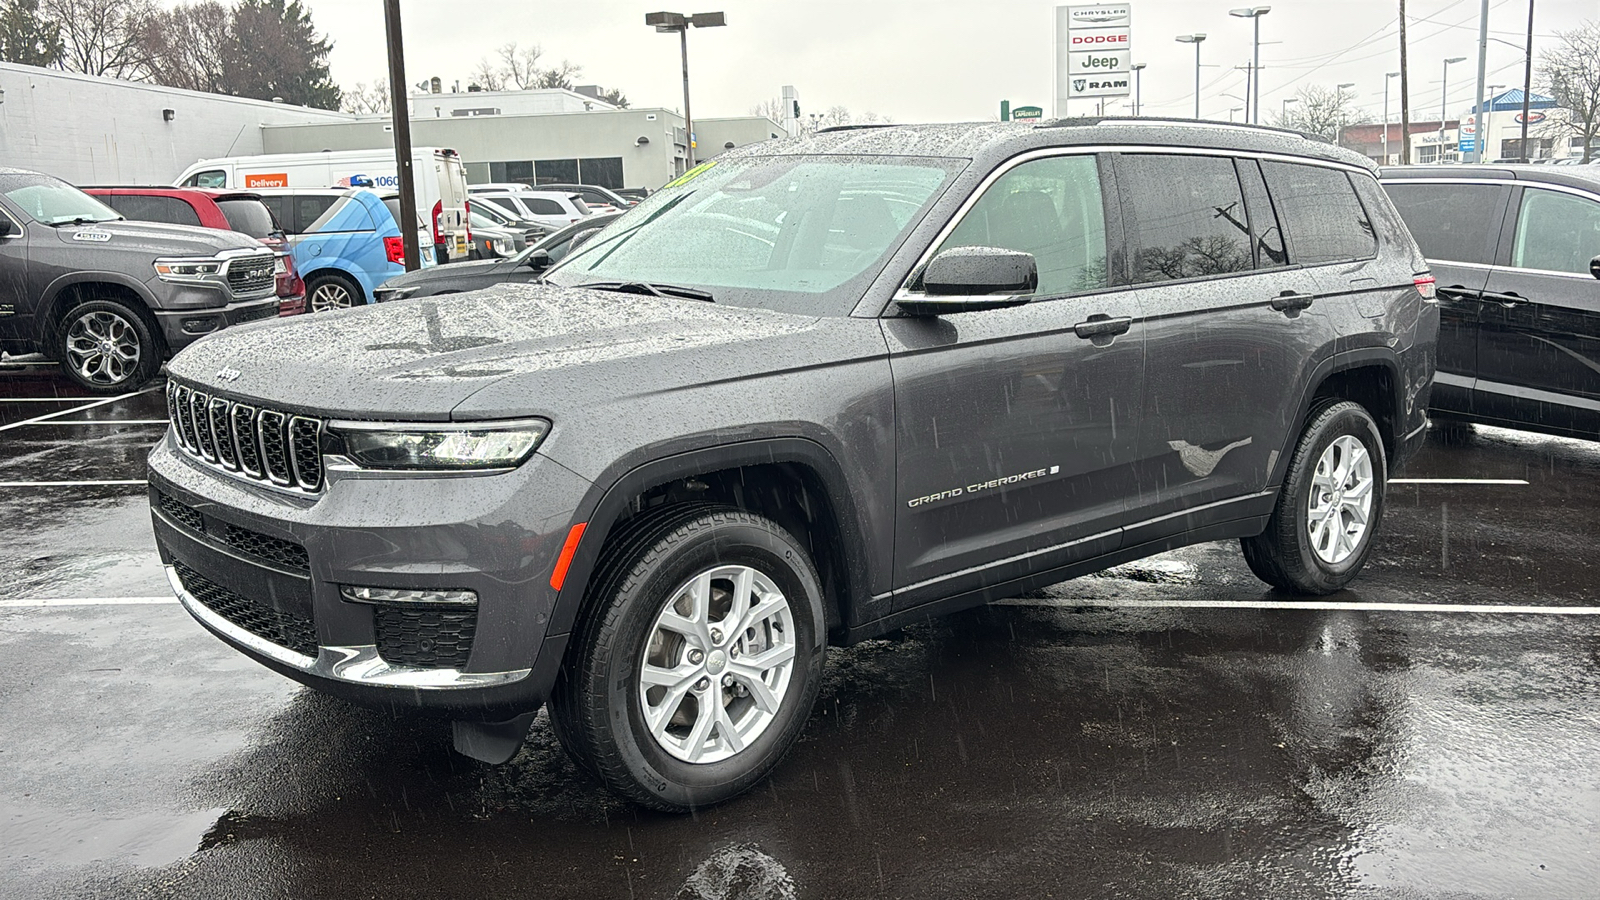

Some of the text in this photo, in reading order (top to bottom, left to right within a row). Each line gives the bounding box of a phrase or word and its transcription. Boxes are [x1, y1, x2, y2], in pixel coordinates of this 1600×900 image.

[1072, 35, 1128, 44] DODGE
[1081, 55, 1119, 70] Jeep
[1088, 80, 1128, 89] RAM
[250, 179, 284, 188] Delivery
[907, 468, 1047, 508] GRAND CHEROKEE
